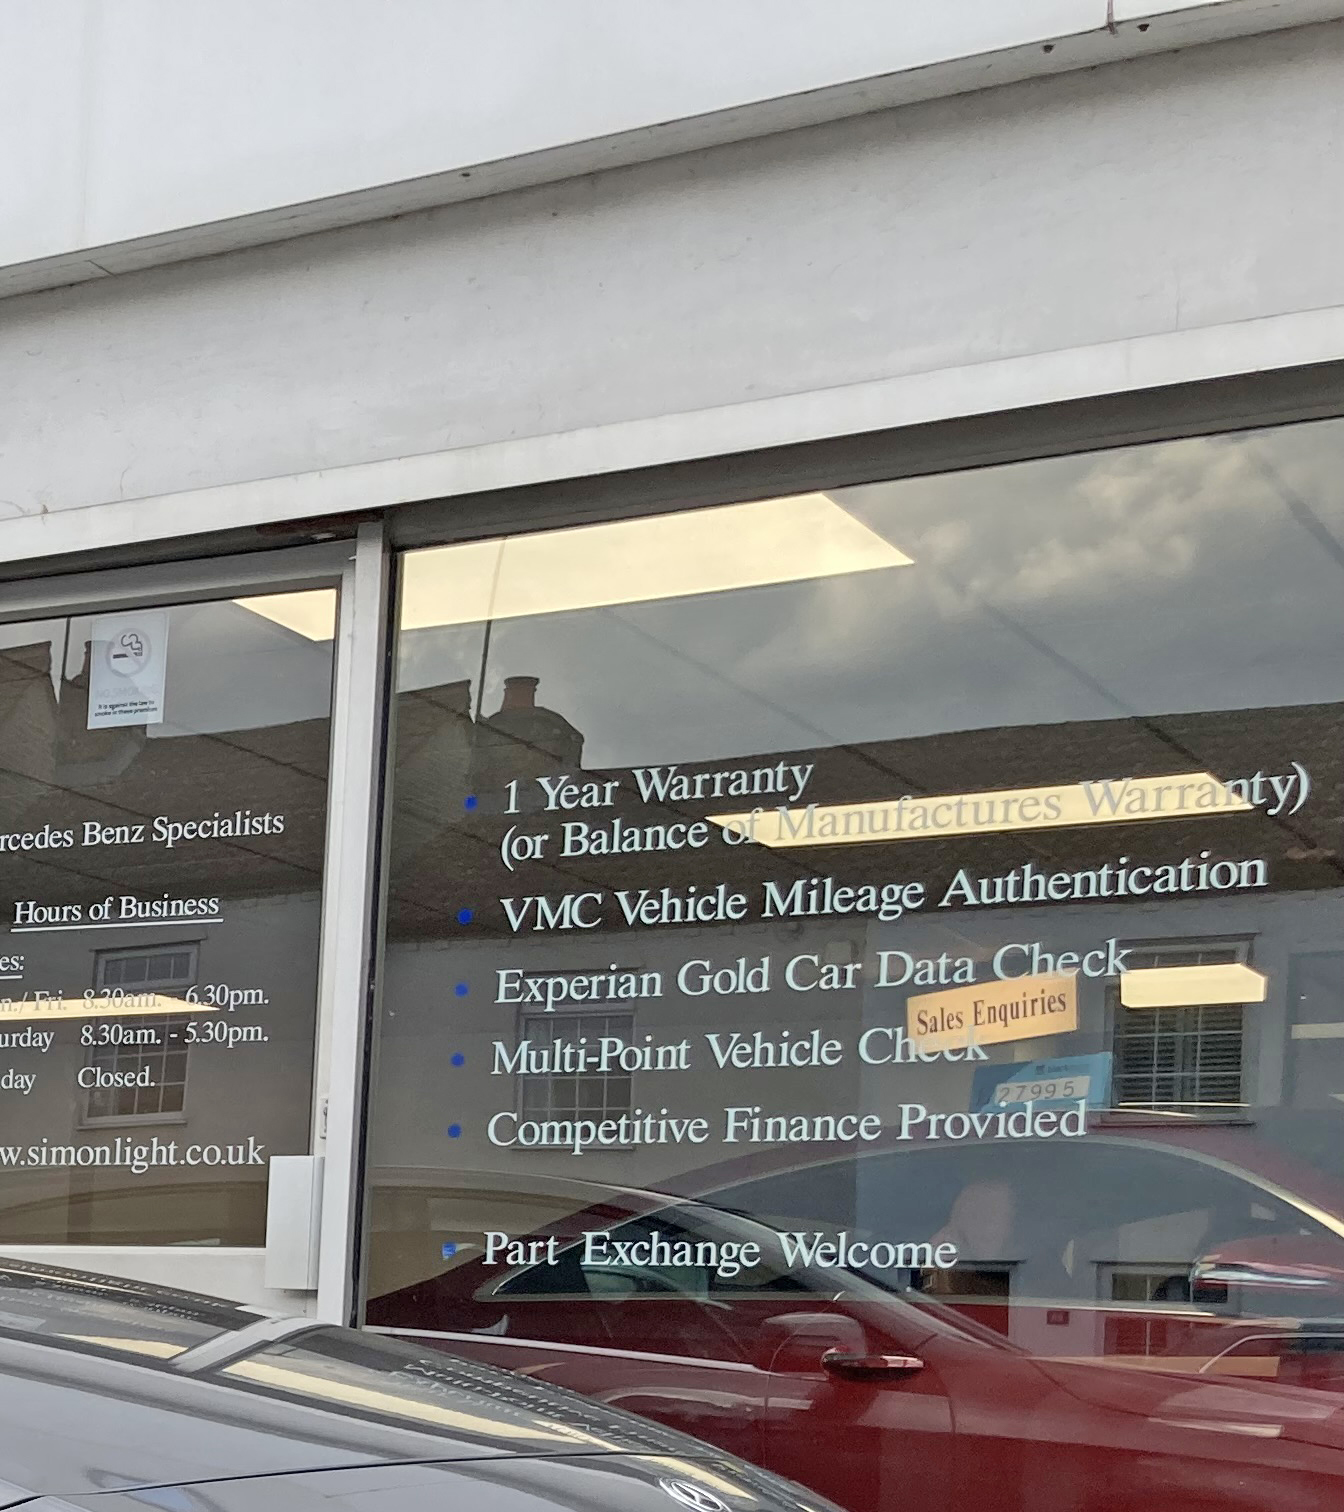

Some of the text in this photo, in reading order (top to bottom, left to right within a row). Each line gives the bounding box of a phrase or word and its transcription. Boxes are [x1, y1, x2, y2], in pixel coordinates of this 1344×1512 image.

[504, 760, 814, 814] 1 Year Warranty
[82, 820, 145, 847] Benz
[152, 811, 285, 849] Specialists
[501, 760, 1310, 872] (or Balance of Manufactures Warranty)
[14, 893, 219, 925] Hours of Business
[500, 849, 1268, 932] VMC Vehicle Mileage Authentication
[34, 990, 67, 1011] Fri.
[82, 988, 161, 1009] 8.30am.
[185, 984, 269, 1009] 6.30pm.
[495, 938, 1133, 1013] Experian Gold Car Data Check
[80, 1024, 161, 1046] 8.30am.
[184, 1020, 269, 1048] 5.30pm.
[917, 988, 1067, 1036] Sales Enquiries
[491, 1025, 990, 1075] Multi-Point Vehicle Check
[78, 1066, 155, 1088] Closed.
[999, 1081, 1075, 1103] 27995
[487, 1100, 1087, 1155] Competitive Finance Provided
[482, 1231, 958, 1278] Part Exchange Welcome
